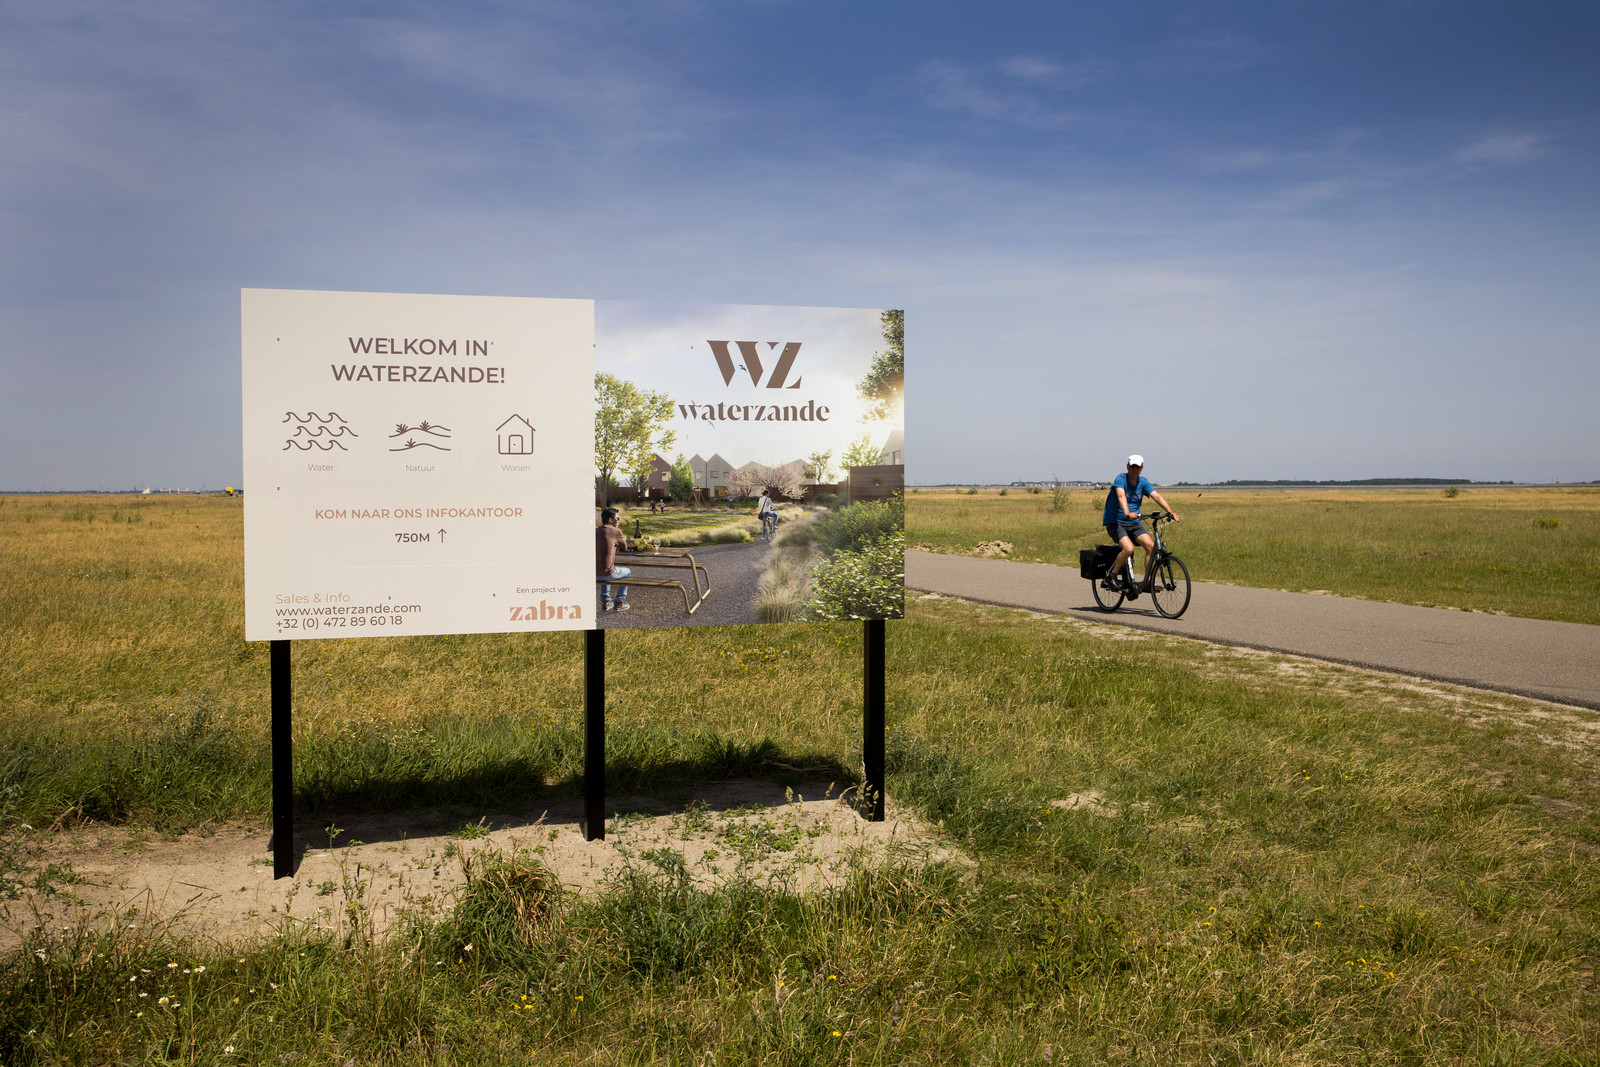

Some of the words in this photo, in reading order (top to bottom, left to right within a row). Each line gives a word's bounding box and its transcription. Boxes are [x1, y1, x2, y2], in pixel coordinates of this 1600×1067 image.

[348, 337, 457, 356] WELKOM
[466, 340, 488, 356] IN
[331, 364, 506, 384] WATERZANDE!
[678, 400, 830, 422] waterzande
[307, 464, 334, 472] Water
[405, 464, 435, 472] Natuur
[501, 464, 531, 472] Wonen
[315, 509, 347, 520] KOM
[351, 508, 390, 519] NAAR
[393, 508, 424, 519] ONS
[426, 507, 523, 519] INFOKANTOOR
[395, 532, 430, 543] 750M
[531, 586, 556, 595] project
[275, 593, 311, 604] Sales
[313, 593, 322, 604] &
[325, 592, 351, 603] Info
[275, 603, 422, 616] www.waterzande.com
[509, 599, 582, 621] zabra
[276, 618, 299, 629] +32
[302, 616, 320, 631] (0)
[323, 616, 347, 628] 472
[350, 616, 367, 627] 89
[369, 615, 387, 627] 60
[389, 615, 403, 626] 18
